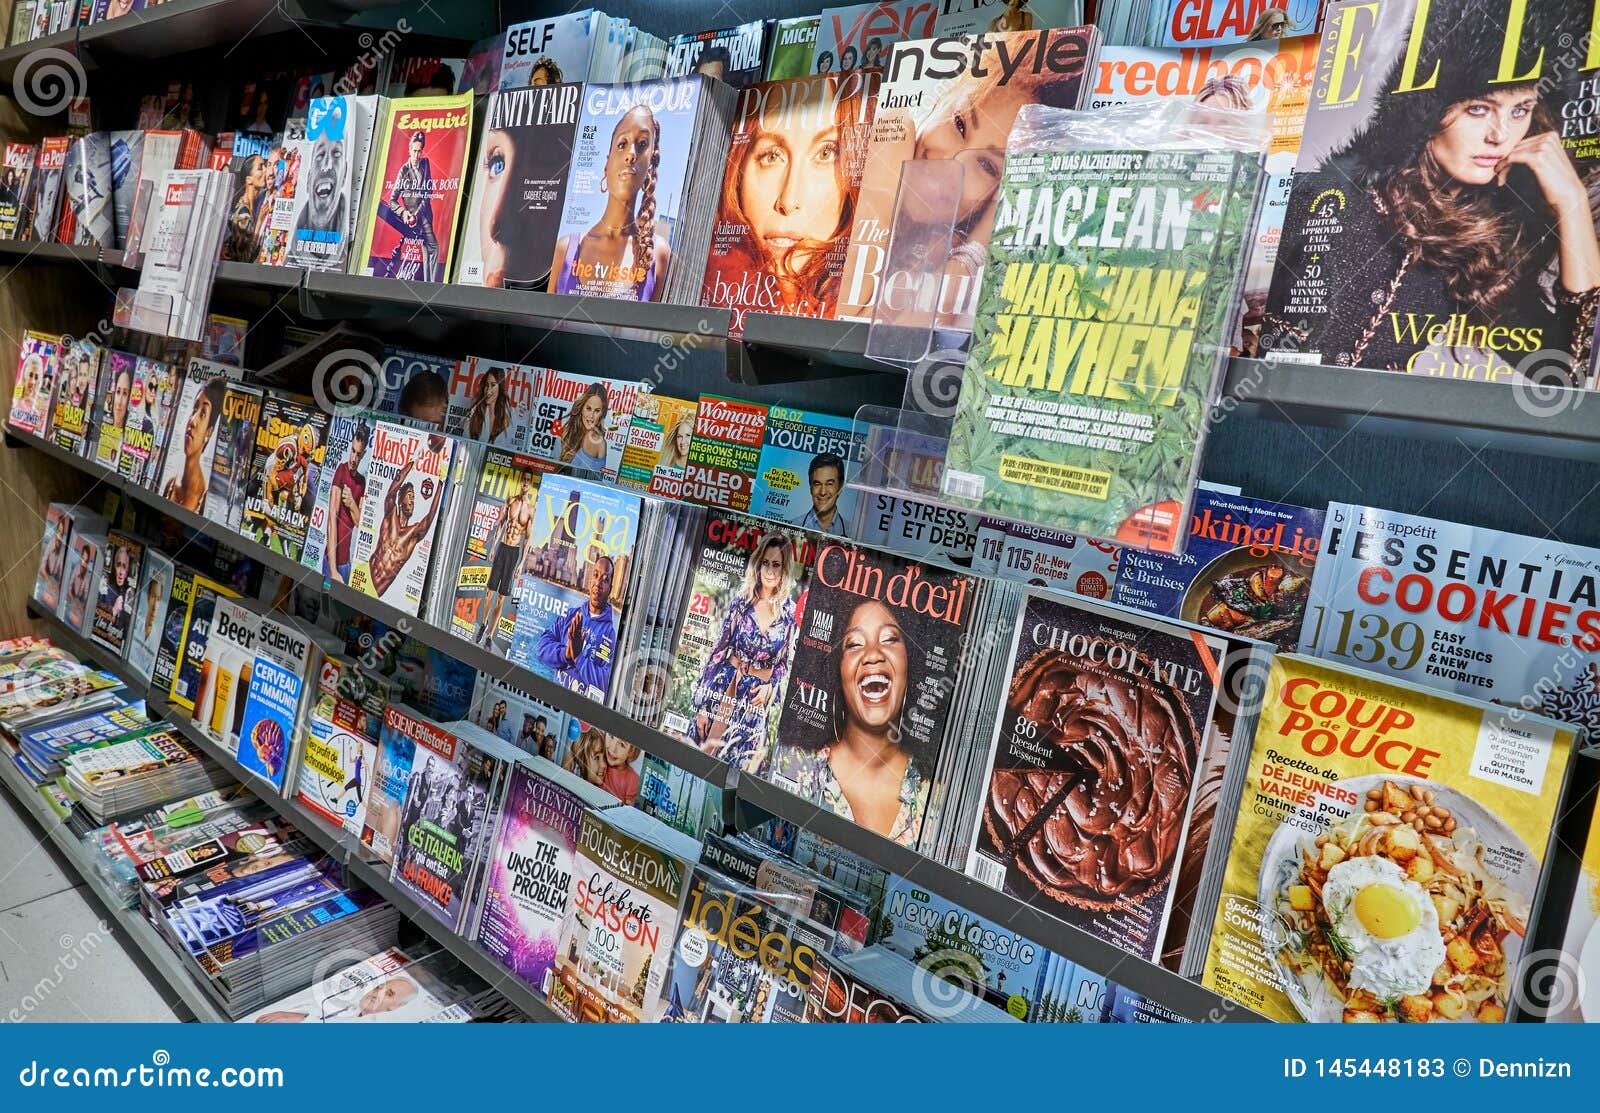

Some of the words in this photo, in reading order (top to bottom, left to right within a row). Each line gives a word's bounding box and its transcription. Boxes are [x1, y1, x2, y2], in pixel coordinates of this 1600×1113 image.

[506, 23, 555, 58] SELF
[880, 89, 924, 109] Janet
[397, 112, 469, 133] Esquire
[1061, 155, 1080, 170] HAS
[1079, 153, 1144, 171] ALZHEIMER'S
[856, 219, 890, 243] The
[571, 258, 593, 278] the
[594, 261, 609, 279] tv
[608, 261, 647, 283] issue
[1283, 304, 1328, 314] PRODUCTS
[1388, 312, 1544, 352] Wellness
[538, 402, 568, 420] GET
[699, 401, 766, 428] Woman's
[696, 417, 745, 441] World
[768, 426, 814, 449] YOUR
[531, 432, 556, 451] GO!
[629, 436, 657, 450] STRESS!
[690, 442, 734, 458] REGROWS
[735, 452, 758, 463] HAIR
[688, 451, 698, 460] IN
[698, 453, 705, 462] 6
[706, 455, 738, 469] WEEKS
[1017, 460, 1049, 475] EVERYTHING
[1049, 465, 1061, 476] YOU
[1061, 466, 1083, 480] WANTED
[685, 465, 743, 491] PALEO
[682, 481, 731, 506] CURE
[765, 496, 791, 508] HEART
[311, 506, 325, 529] 50
[475, 501, 500, 518] MOVES
[1209, 498, 1226, 510] What
[1226, 501, 1256, 517] Healthy
[1256, 506, 1278, 518] Means
[1277, 510, 1294, 521] Now
[470, 527, 488, 541] LEAN
[538, 494, 631, 565] yoga
[902, 520, 926, 540] ET
[1012, 521, 1074, 546] magazine
[703, 547, 715, 559] ON
[715, 550, 746, 568] CUISINE
[1008, 545, 1032, 570] 115
[1034, 552, 1071, 571] All-New
[1126, 553, 1163, 572] Stews
[817, 545, 882, 601] Clin
[1033, 564, 1068, 582] Recipes
[1137, 569, 1185, 591] Braises
[520, 586, 570, 618] FUTURE
[1120, 584, 1149, 598] Hearty
[455, 596, 482, 623] SEX
[690, 593, 711, 615] 25
[1357, 565, 1600, 653] COOKIES
[811, 609, 834, 632] YAMA
[217, 612, 255, 650] Beer
[259, 625, 306, 661] SCIENCE
[1433, 630, 1467, 645] EASY
[1032, 622, 1203, 697] CHOCOLATE
[1428, 654, 1438, 663] &
[1439, 655, 1468, 671] NEW
[1430, 642, 1493, 664] CLASSICS
[254, 662, 297, 695] CERVEAU
[1425, 664, 1495, 689] FAVORITES
[1279, 678, 1415, 738] COUP
[1014, 716, 1037, 739] 86
[1320, 718, 1341, 732] de
[1011, 733, 1054, 760] Decadent
[1278, 710, 1441, 779] POUCE
[1009, 745, 1047, 769] Desserts
[1266, 748, 1318, 776] Recettes
[1320, 768, 1339, 782] de
[1490, 760, 1526, 775] QUITTER
[1494, 752, 1526, 767] doivent
[1261, 763, 1358, 807] DÉJEUNERS
[1479, 765, 1500, 776] LEUR
[1500, 771, 1533, 786] MAISON
[1254, 792, 1297, 815] matins
[1297, 804, 1331, 827] salés
[1259, 778, 1316, 808] VARIÉS
[1318, 801, 1351, 820] pour
[425, 833, 464, 874] ITALIENS
[535, 840, 558, 865] THE
[580, 821, 622, 865] HOUSE
[704, 844, 722, 861] EN
[723, 851, 757, 879] PRIME
[415, 866, 453, 907] FRANCE
[512, 875, 569, 914] PROBLEM
[588, 872, 653, 925] Celebrate
[574, 879, 660, 953] SEASON
[890, 891, 941, 928] New
[943, 910, 1034, 965] Classic
[683, 881, 816, 992] idées
